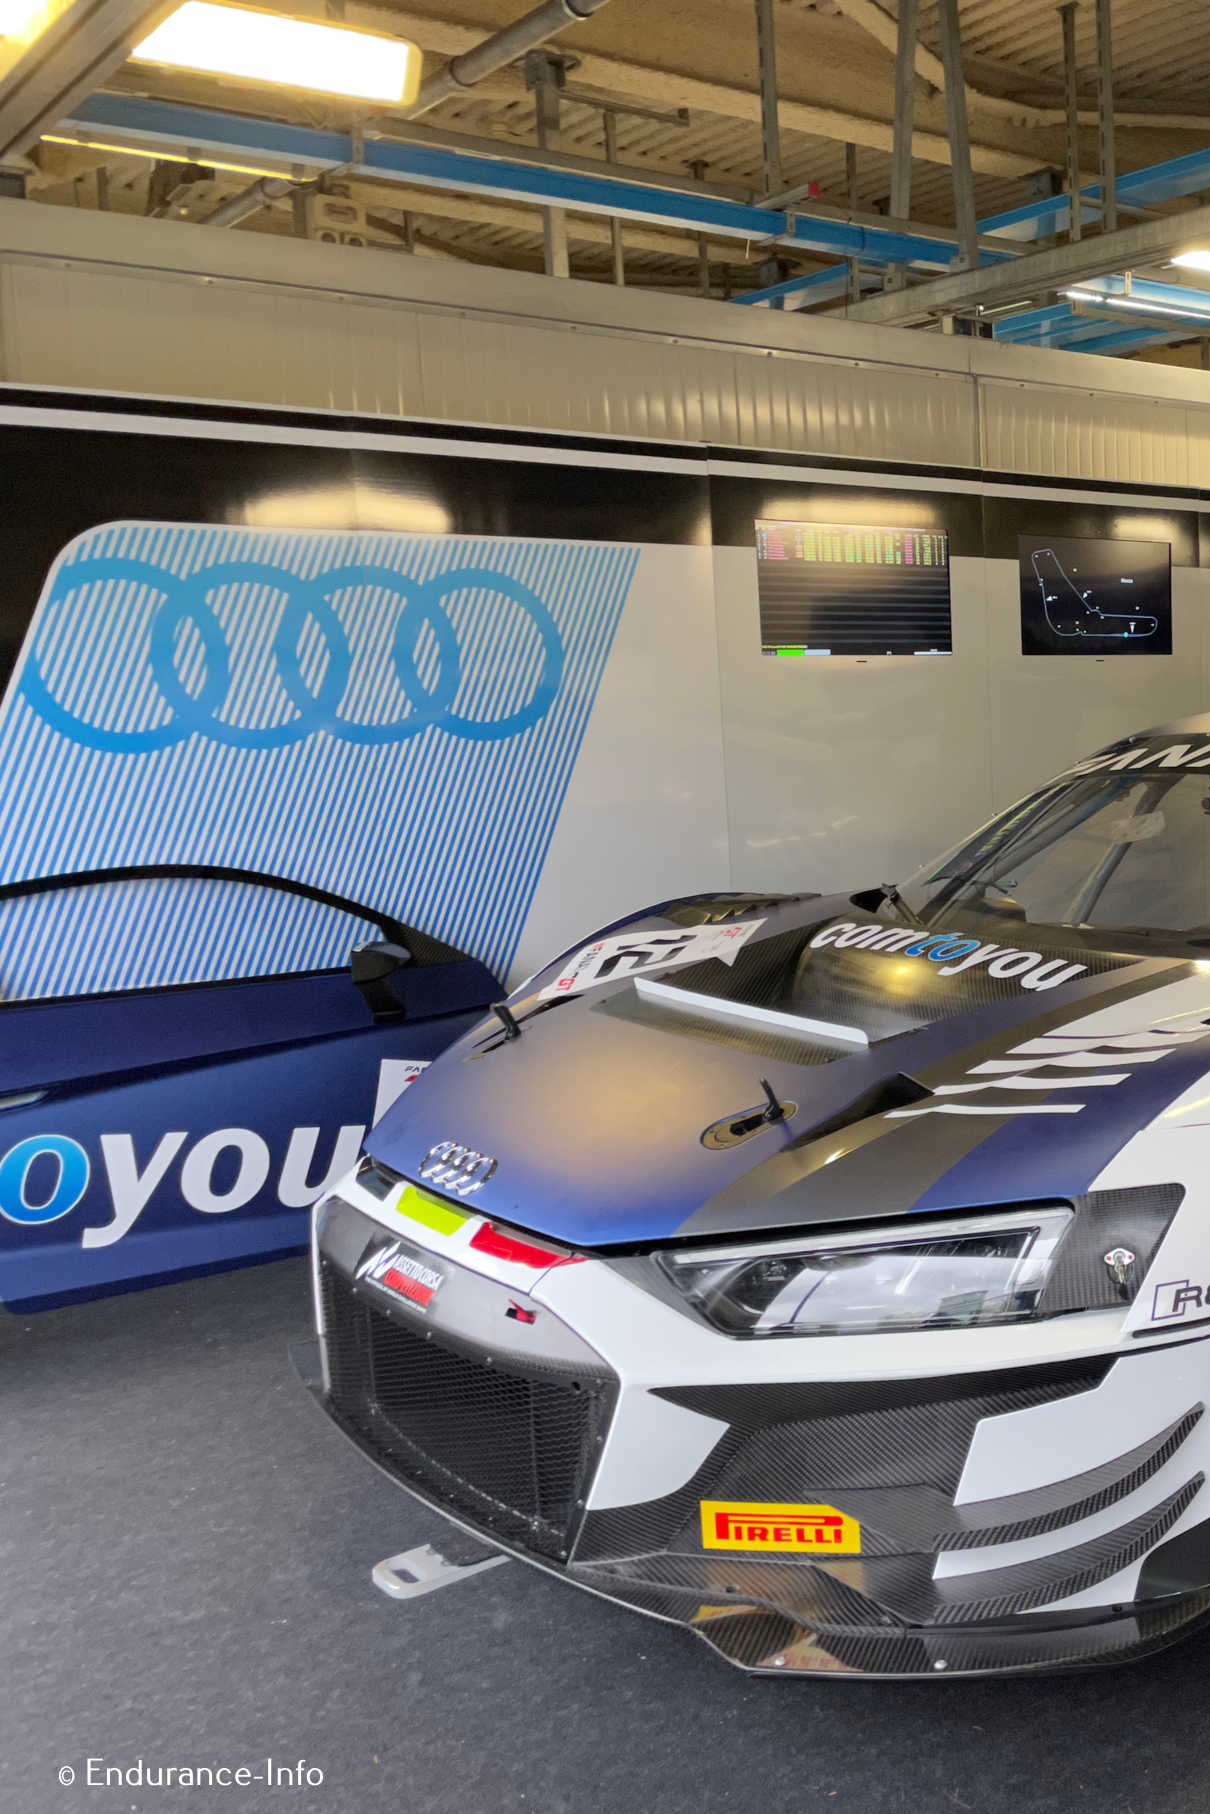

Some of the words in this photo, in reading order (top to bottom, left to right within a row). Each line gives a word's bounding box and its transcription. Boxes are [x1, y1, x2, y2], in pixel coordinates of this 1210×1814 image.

[809, 922, 1088, 992] comtoyou
[0, 1124, 365, 1249] oyou
[715, 1512, 843, 1544] PIRELLI
